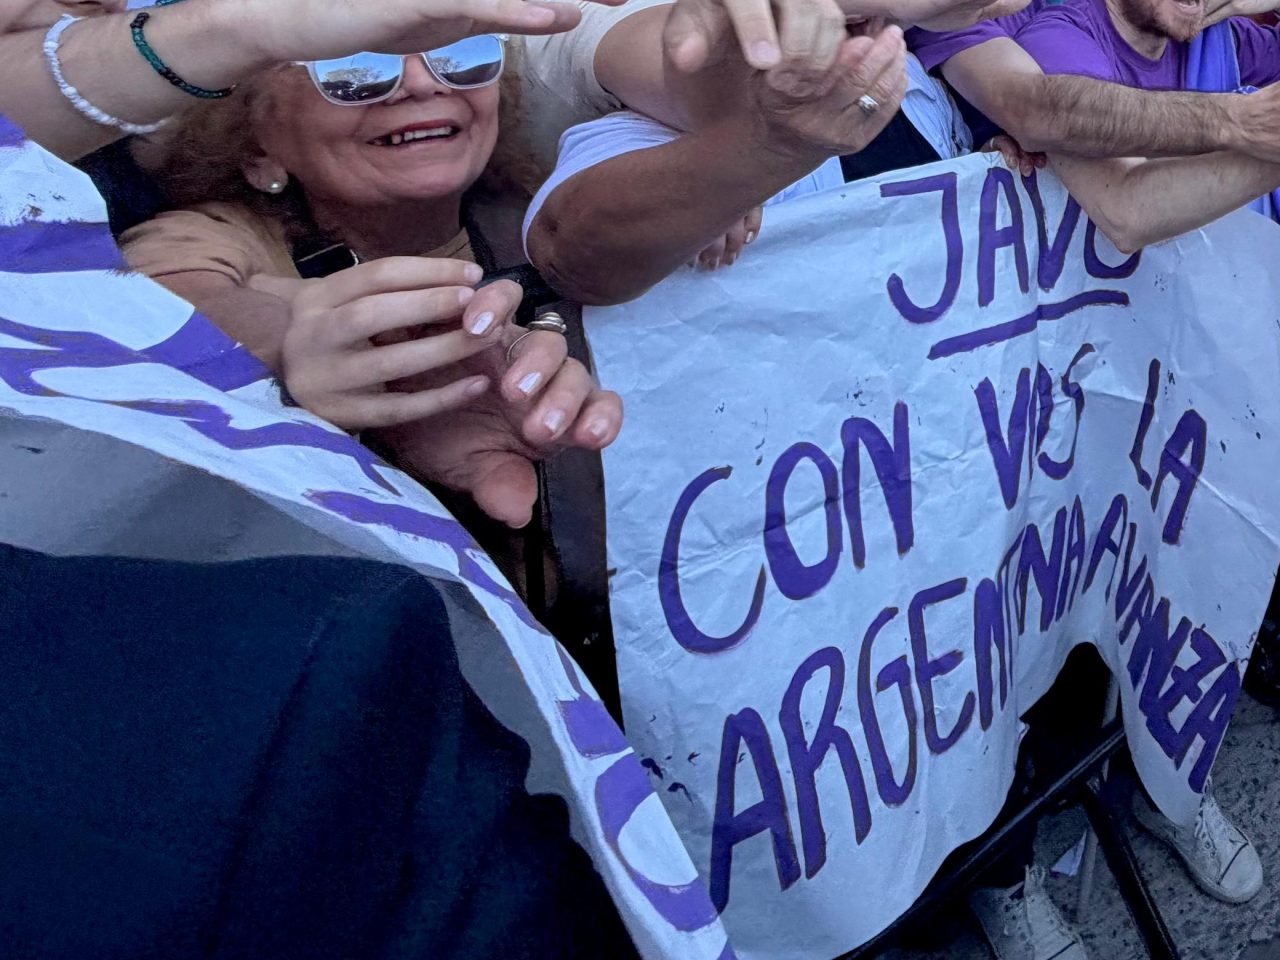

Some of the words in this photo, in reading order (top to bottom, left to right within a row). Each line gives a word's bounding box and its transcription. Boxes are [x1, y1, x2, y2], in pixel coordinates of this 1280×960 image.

[657, 399, 914, 655] CON
[974, 342, 1095, 511] VOS
[1128, 358, 1207, 546] LA
[1081, 490, 1242, 794] AVANZA
